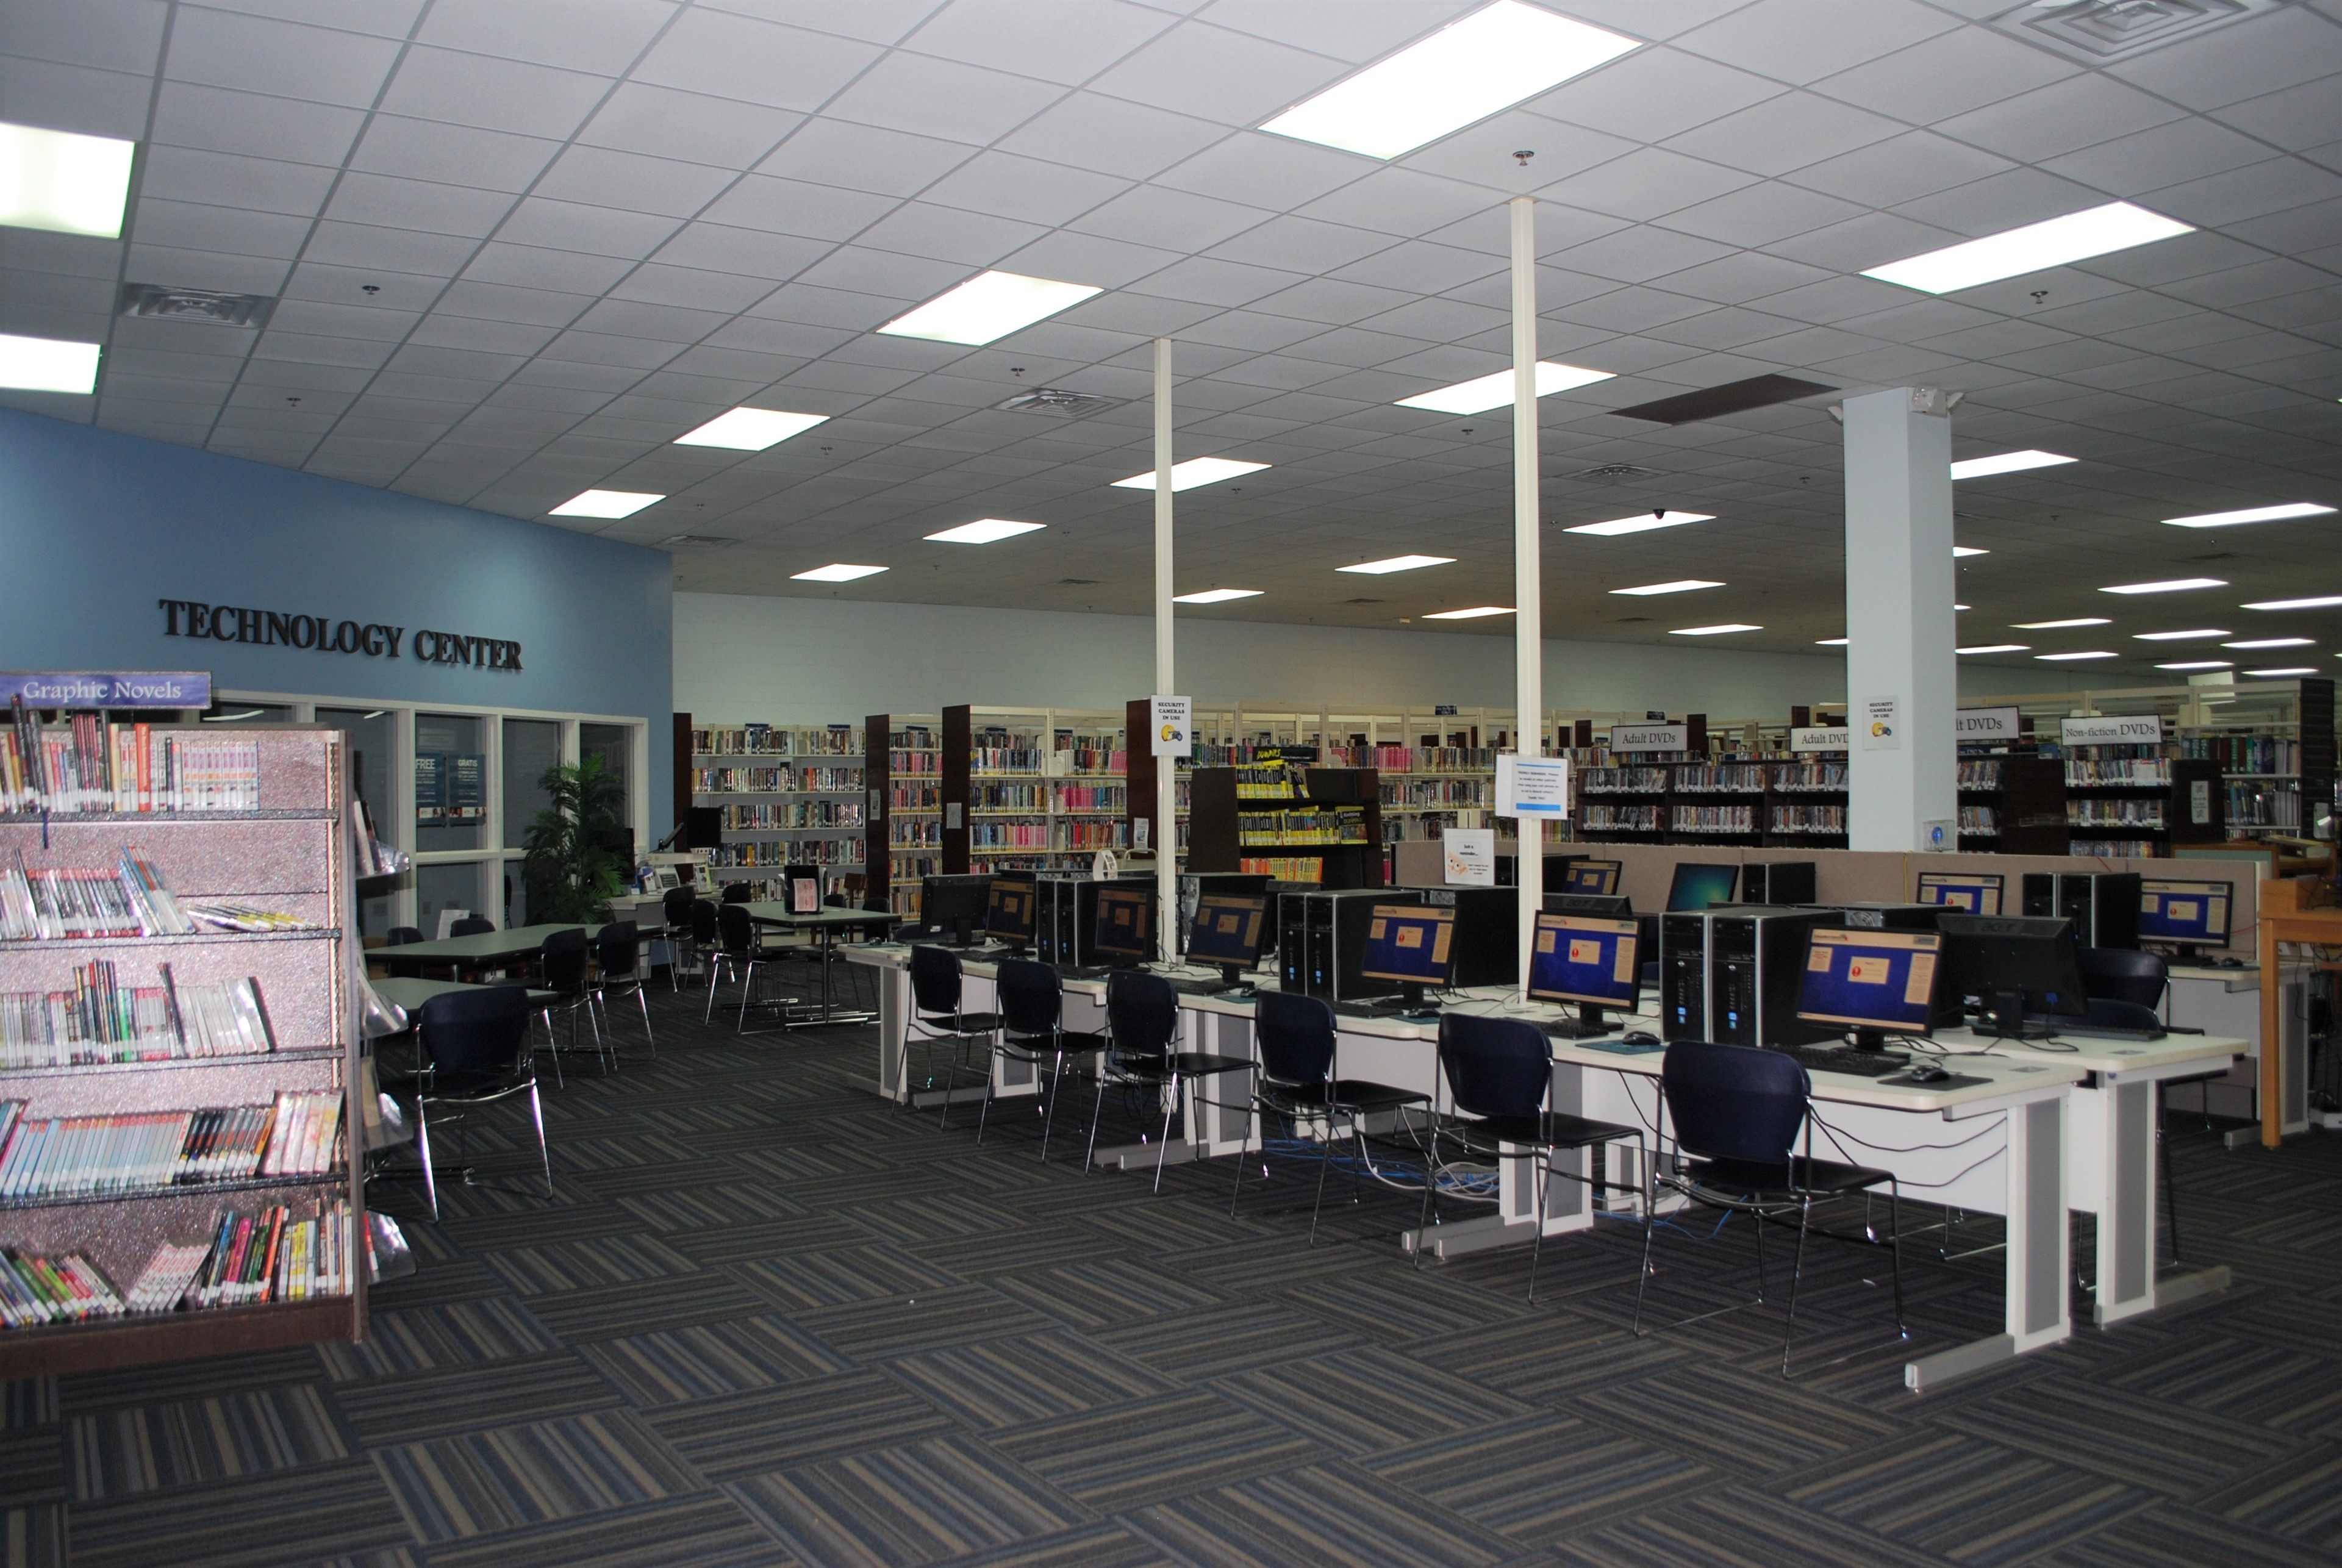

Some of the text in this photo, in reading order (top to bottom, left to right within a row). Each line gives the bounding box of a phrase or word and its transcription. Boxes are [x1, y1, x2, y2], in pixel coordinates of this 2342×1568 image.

[159, 599, 524, 670] TECHNOLOGY CENTER
[23, 680, 182, 703] Graphic Novels
[1966, 717, 2002, 731] DVDs
[2066, 723, 2155, 737] Non-fiction DVDs
[1622, 732, 1676, 744] Adult DVDs
[1802, 734, 1826, 744] Adult
[457, 759, 478, 767] GRATIS
